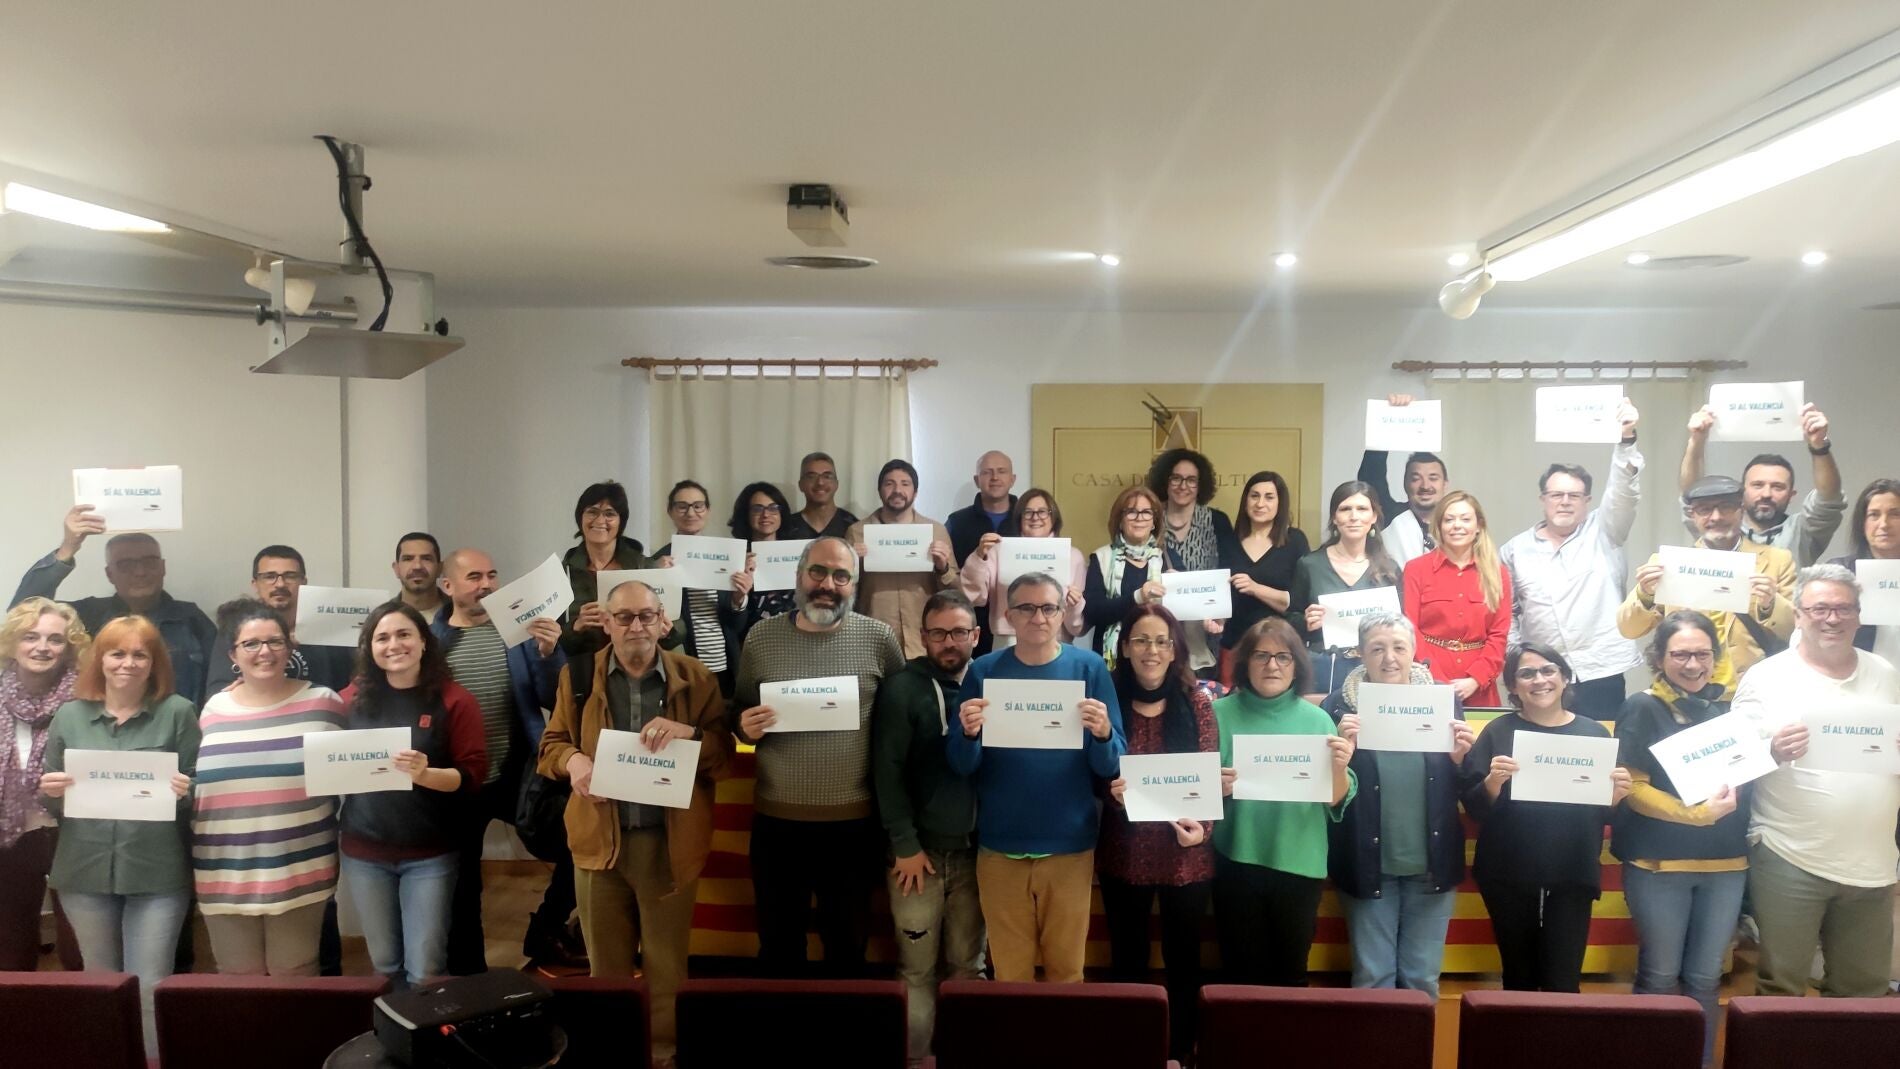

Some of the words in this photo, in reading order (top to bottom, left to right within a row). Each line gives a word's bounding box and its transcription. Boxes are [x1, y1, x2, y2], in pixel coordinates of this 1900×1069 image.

[1072, 473, 1123, 487] CASA
[113, 488, 123, 496] AL
[1687, 567, 1697, 575] AL
[1014, 703, 1025, 711] AL
[1388, 706, 1398, 714] AL
[1832, 726, 1844, 734] AL
[338, 754, 348, 762] AL
[627, 755, 638, 764] AL
[1692, 751, 1701, 760] AL
[1544, 757, 1555, 766] AL
[100, 772, 112, 780] AL
[1152, 776, 1162, 785] AL
